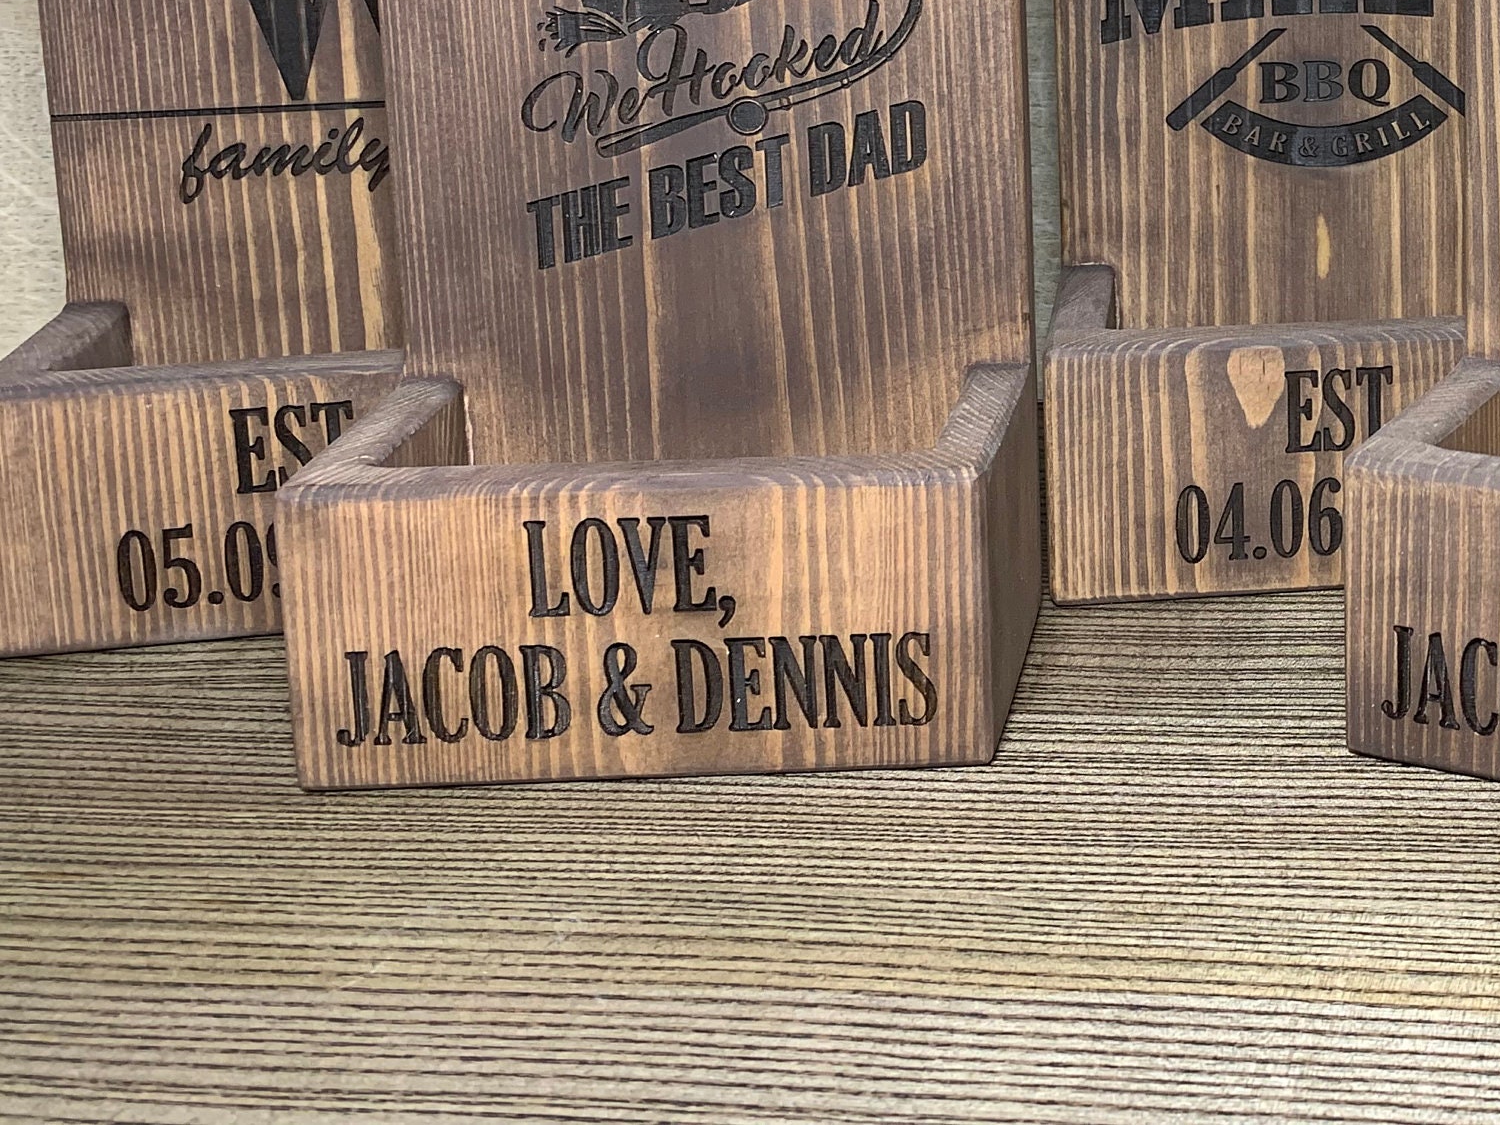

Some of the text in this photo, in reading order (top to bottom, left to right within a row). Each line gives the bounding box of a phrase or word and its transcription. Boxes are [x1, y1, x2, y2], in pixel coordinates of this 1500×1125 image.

[521, 70, 650, 144] We
[1259, 59, 1392, 107] BBQ
[179, 117, 389, 204] family
[1221, 111, 1431, 158] BAR & GRILL
[526, 99, 929, 271] THE BEST DAD
[1175, 477, 1344, 564] 04.06
[116, 521, 281, 612] 05.0
[522, 514, 737, 628] LOVE,
[337, 631, 939, 747] JACOB & DENNIS
